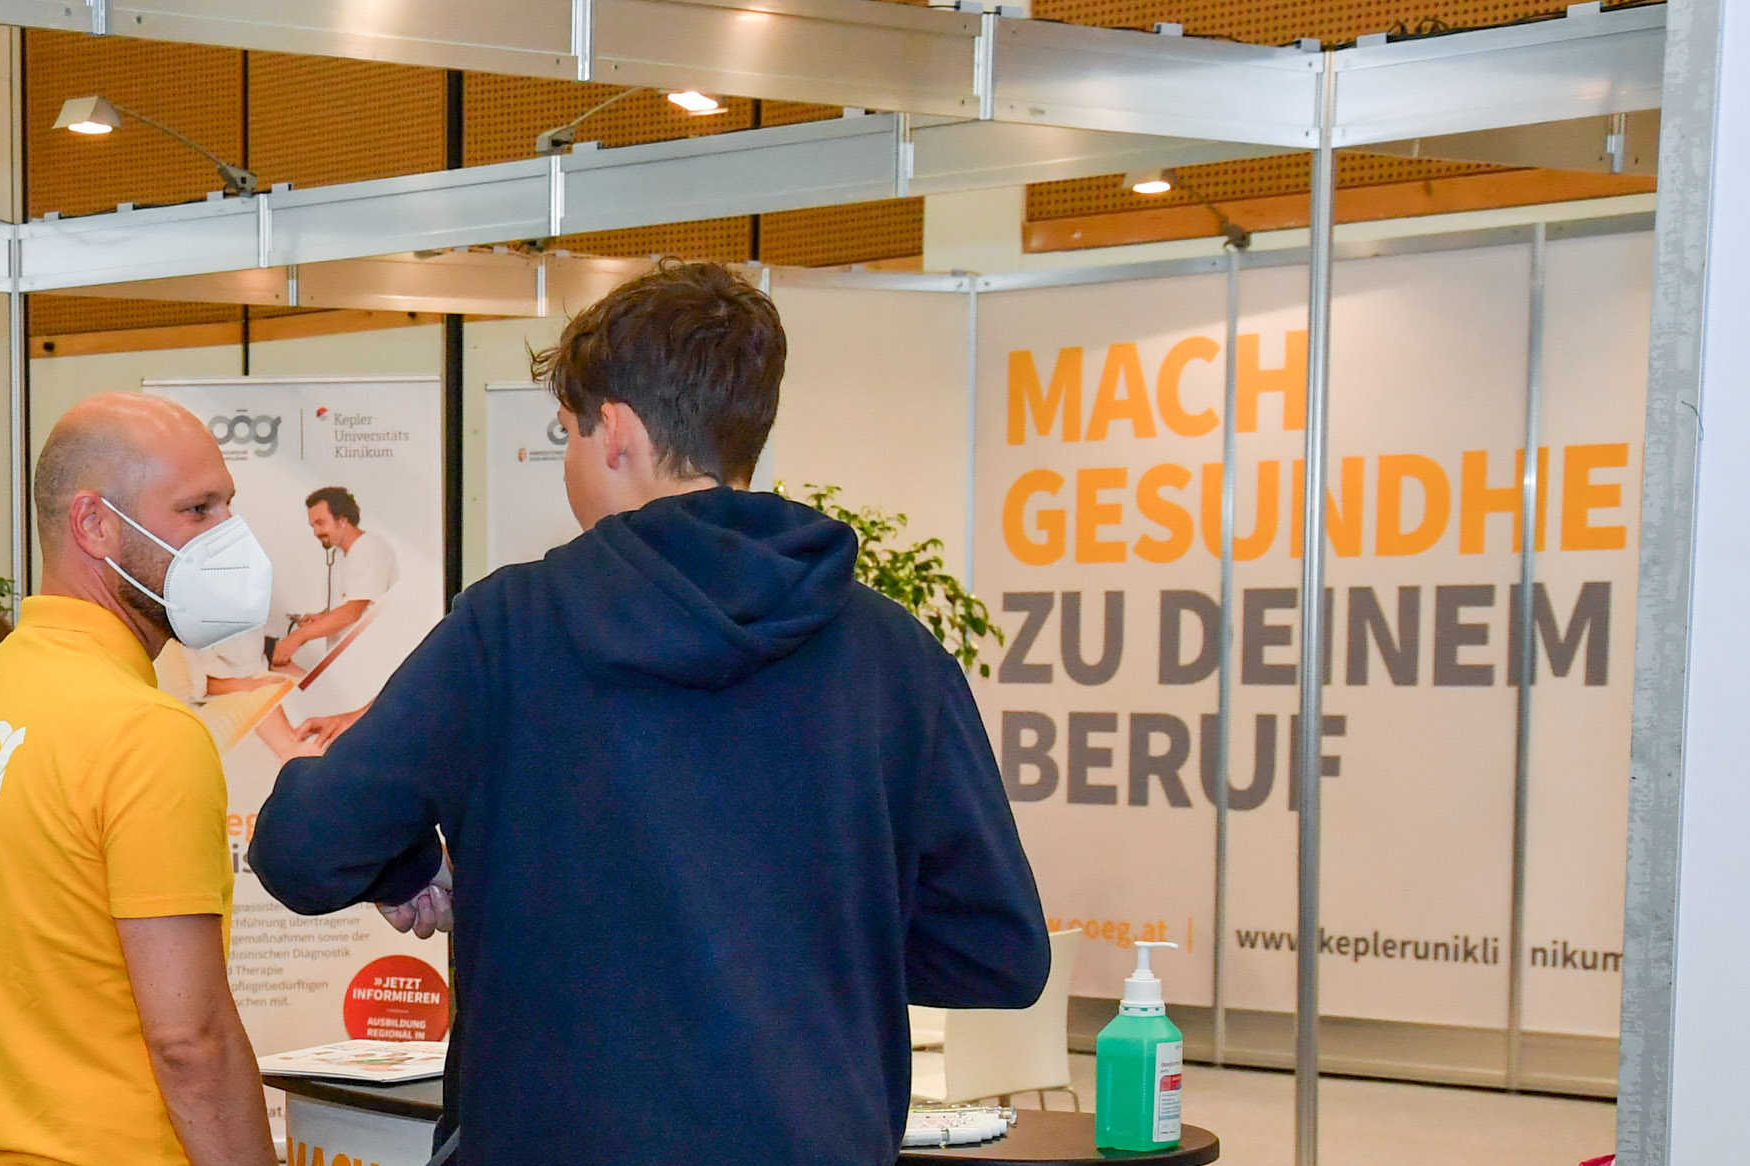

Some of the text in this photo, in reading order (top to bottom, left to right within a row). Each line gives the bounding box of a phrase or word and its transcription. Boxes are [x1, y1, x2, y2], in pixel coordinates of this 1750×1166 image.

[1007, 328, 1309, 446] MACH
[334, 413, 373, 430] Kepler
[334, 428, 410, 442] Universitäts
[334, 445, 393, 459] Klinikum
[1002, 443, 1629, 567] GESUNDHE
[998, 581, 1613, 687] ZU DEINEM
[1000, 710, 1347, 812] BERUF
[289, 916, 360, 928] übertragener
[317, 934, 349, 943] sowie
[352, 932, 370, 942] der
[293, 948, 351, 961] Diagnostik
[236, 965, 284, 977] Therapie
[352, 988, 440, 1005] INFORMIEREN
[367, 1017, 427, 1029] AUSBILDUNG
[367, 1028, 425, 1040] REGIONAL IN
